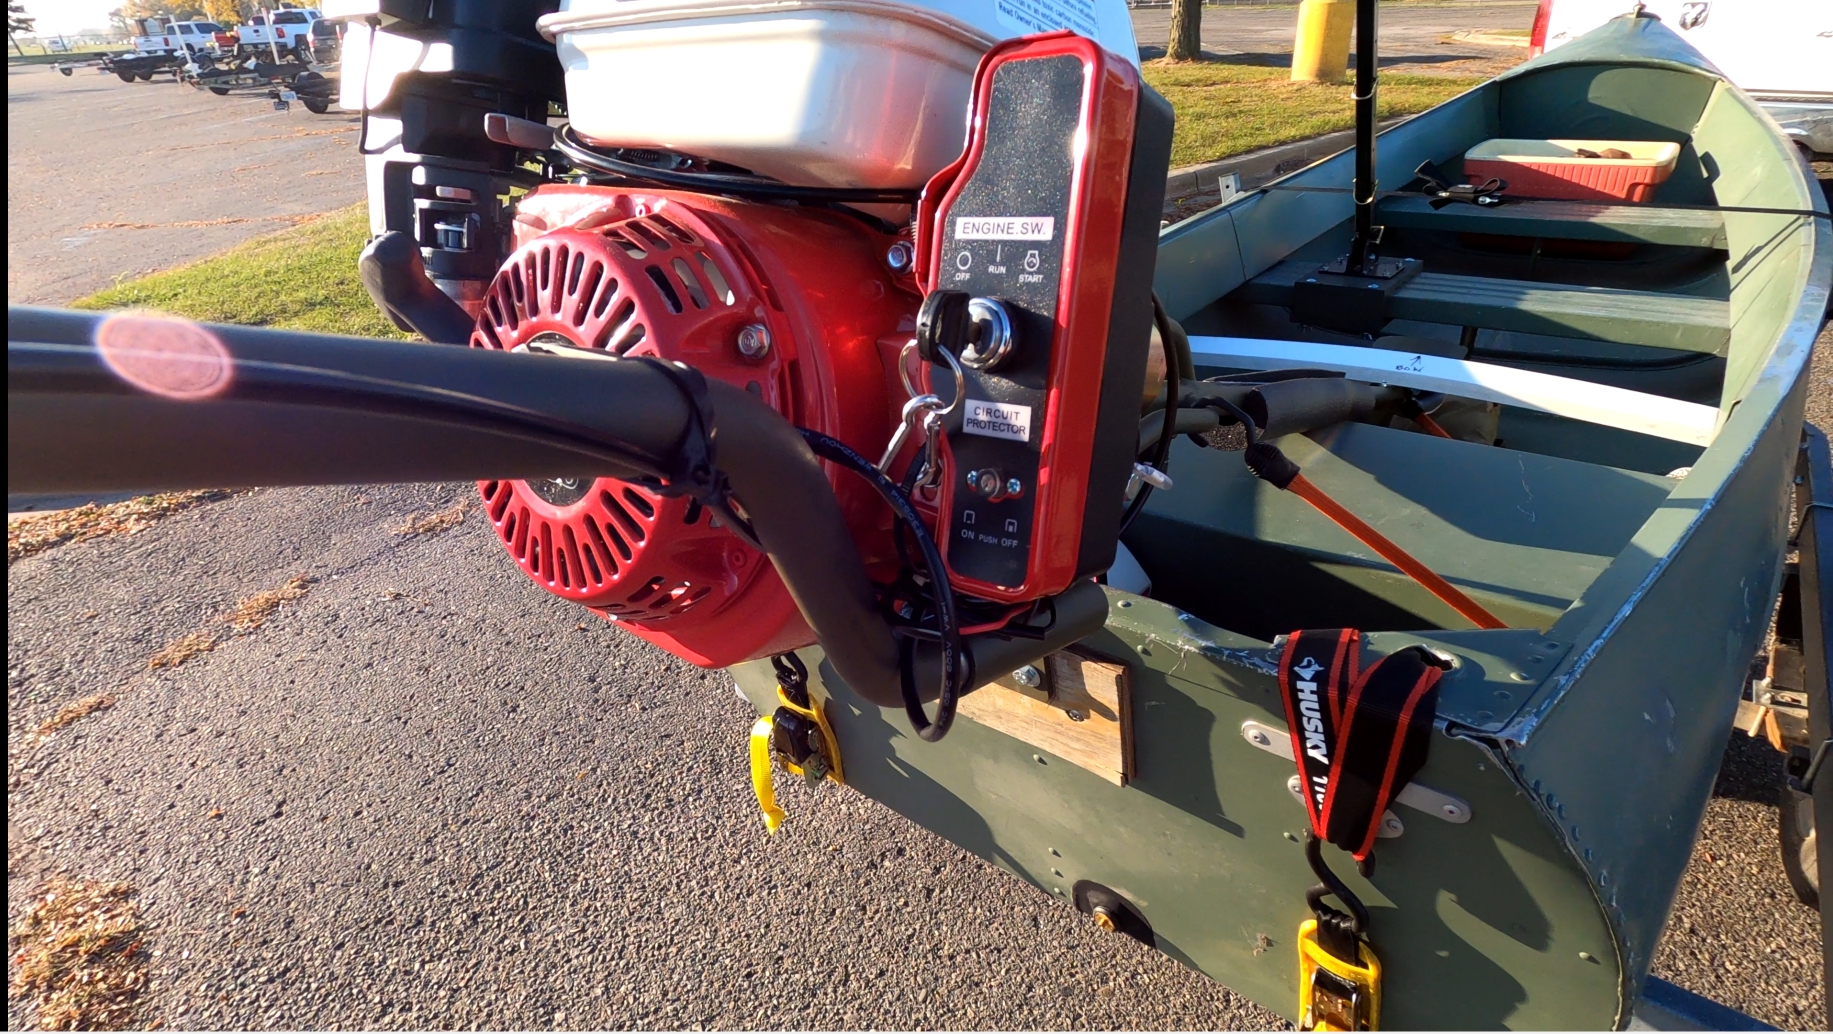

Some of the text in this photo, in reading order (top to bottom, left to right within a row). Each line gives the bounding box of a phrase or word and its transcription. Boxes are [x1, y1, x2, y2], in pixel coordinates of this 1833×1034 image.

[998, 1, 1014, 17] Read
[1015, 10, 1036, 30] Owner's
[962, 221, 1047, 235] ENGINE.SW.
[955, 272, 971, 281] OFF
[988, 265, 1007, 274] RUN
[1019, 274, 1044, 283] START
[974, 406, 1021, 421] CIRCUIT
[966, 418, 1026, 435] PROTECTOR
[820, 436, 873, 472] WENZHOU
[961, 528, 1019, 549] ON PUSH OFF
[1296, 680, 1330, 765] HUSKY
